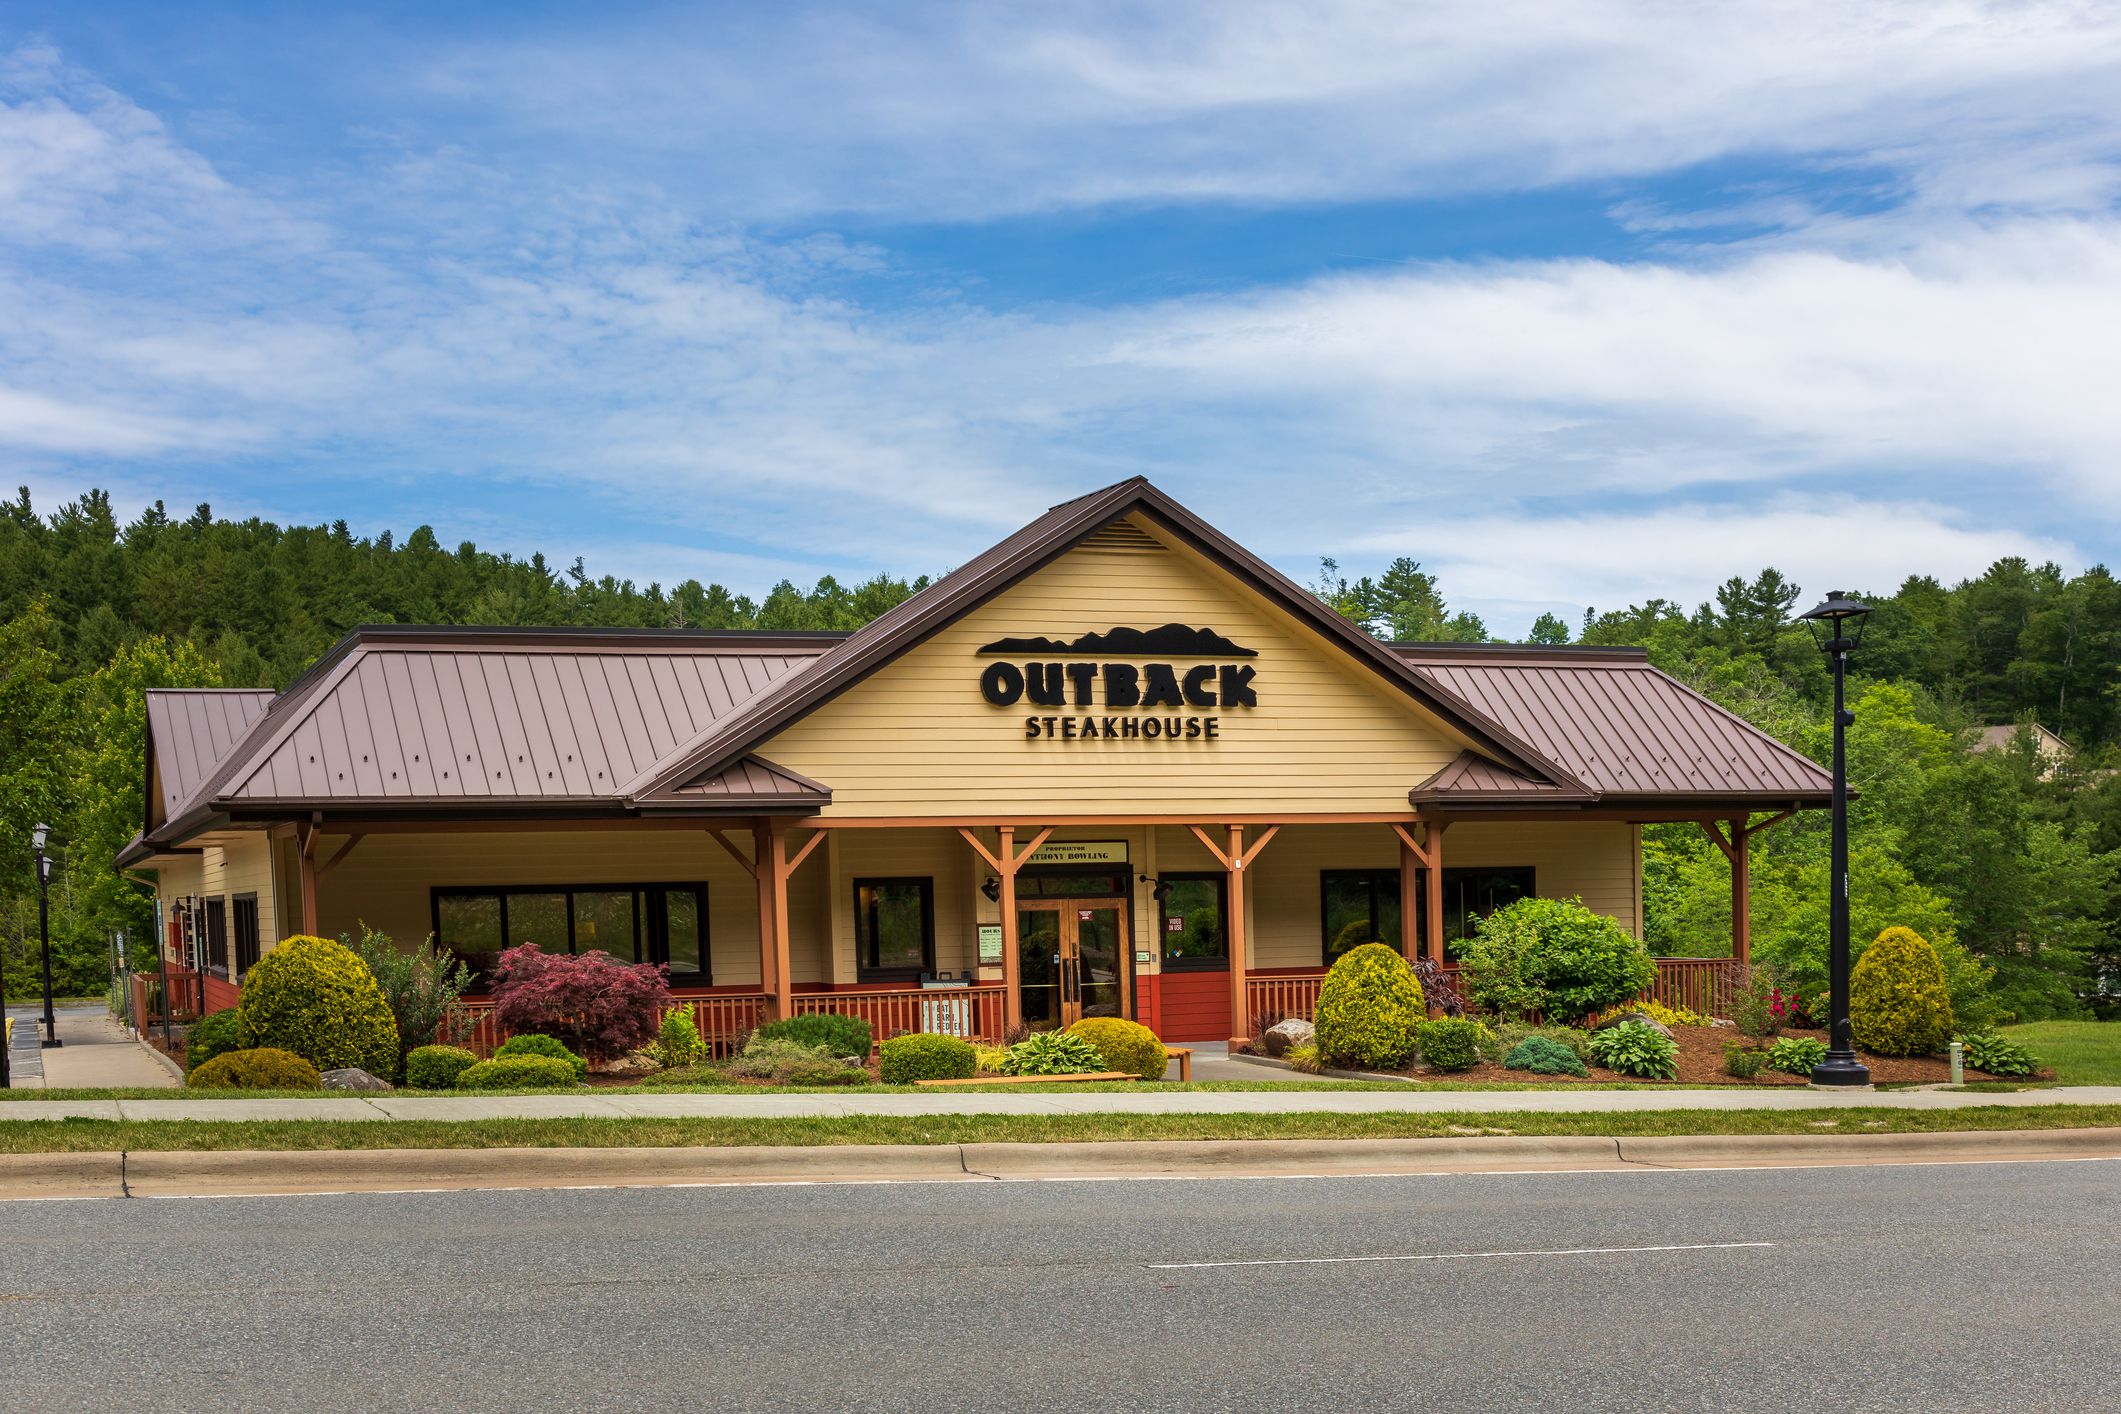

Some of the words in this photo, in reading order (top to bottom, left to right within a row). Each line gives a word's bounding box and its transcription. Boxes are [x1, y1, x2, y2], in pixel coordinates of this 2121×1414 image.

[980, 661, 1257, 707] OUTBACK
[1025, 716, 1219, 738] STEAKHOUSE
[1068, 852, 1108, 860] BOWLING
